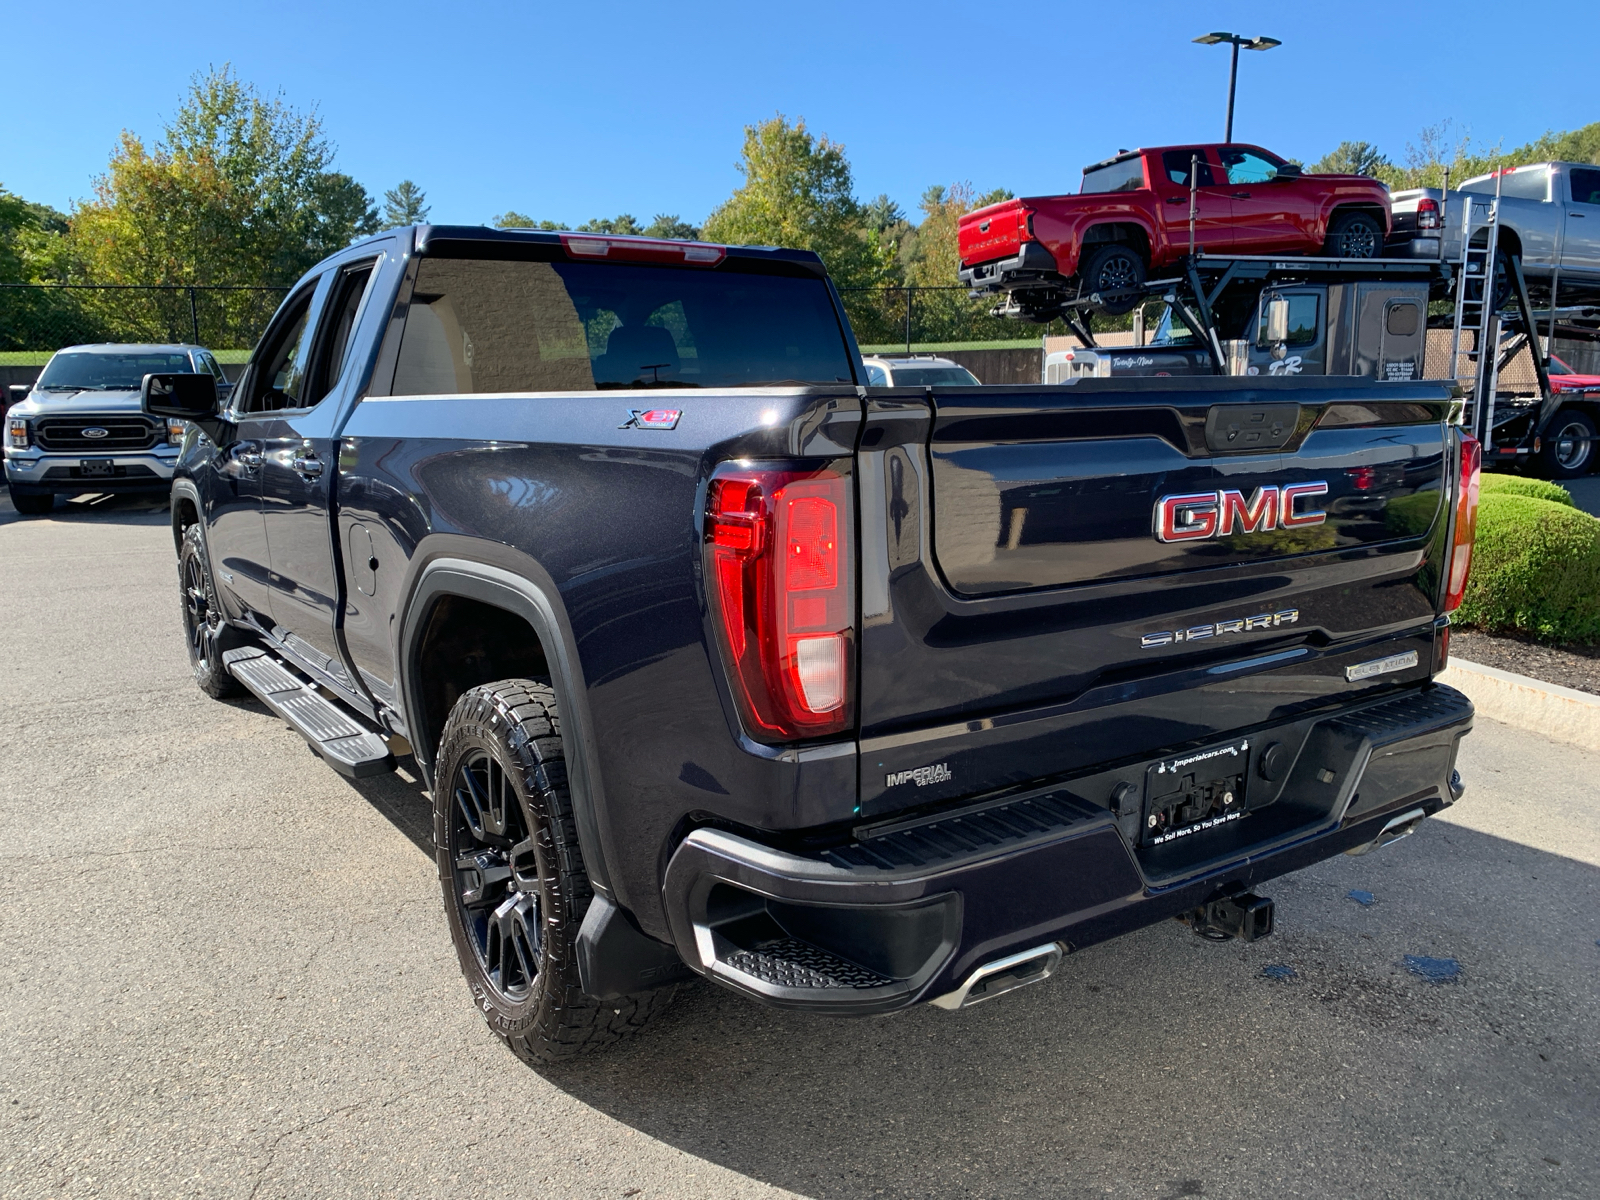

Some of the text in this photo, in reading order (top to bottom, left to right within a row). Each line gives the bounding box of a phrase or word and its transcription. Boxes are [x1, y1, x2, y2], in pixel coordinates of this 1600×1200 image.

[1113, 357, 1153, 368] Twenty-Nine
[1152, 480, 1328, 543] GMC
[1140, 609, 1299, 649] SIERRA
[1352, 654, 1416, 677] ELEVATION
[886, 762, 952, 787] IMPERIAL
[916, 773, 952, 787] cars.com
[1154, 812, 1240, 845] We Sell More, So You Save More
